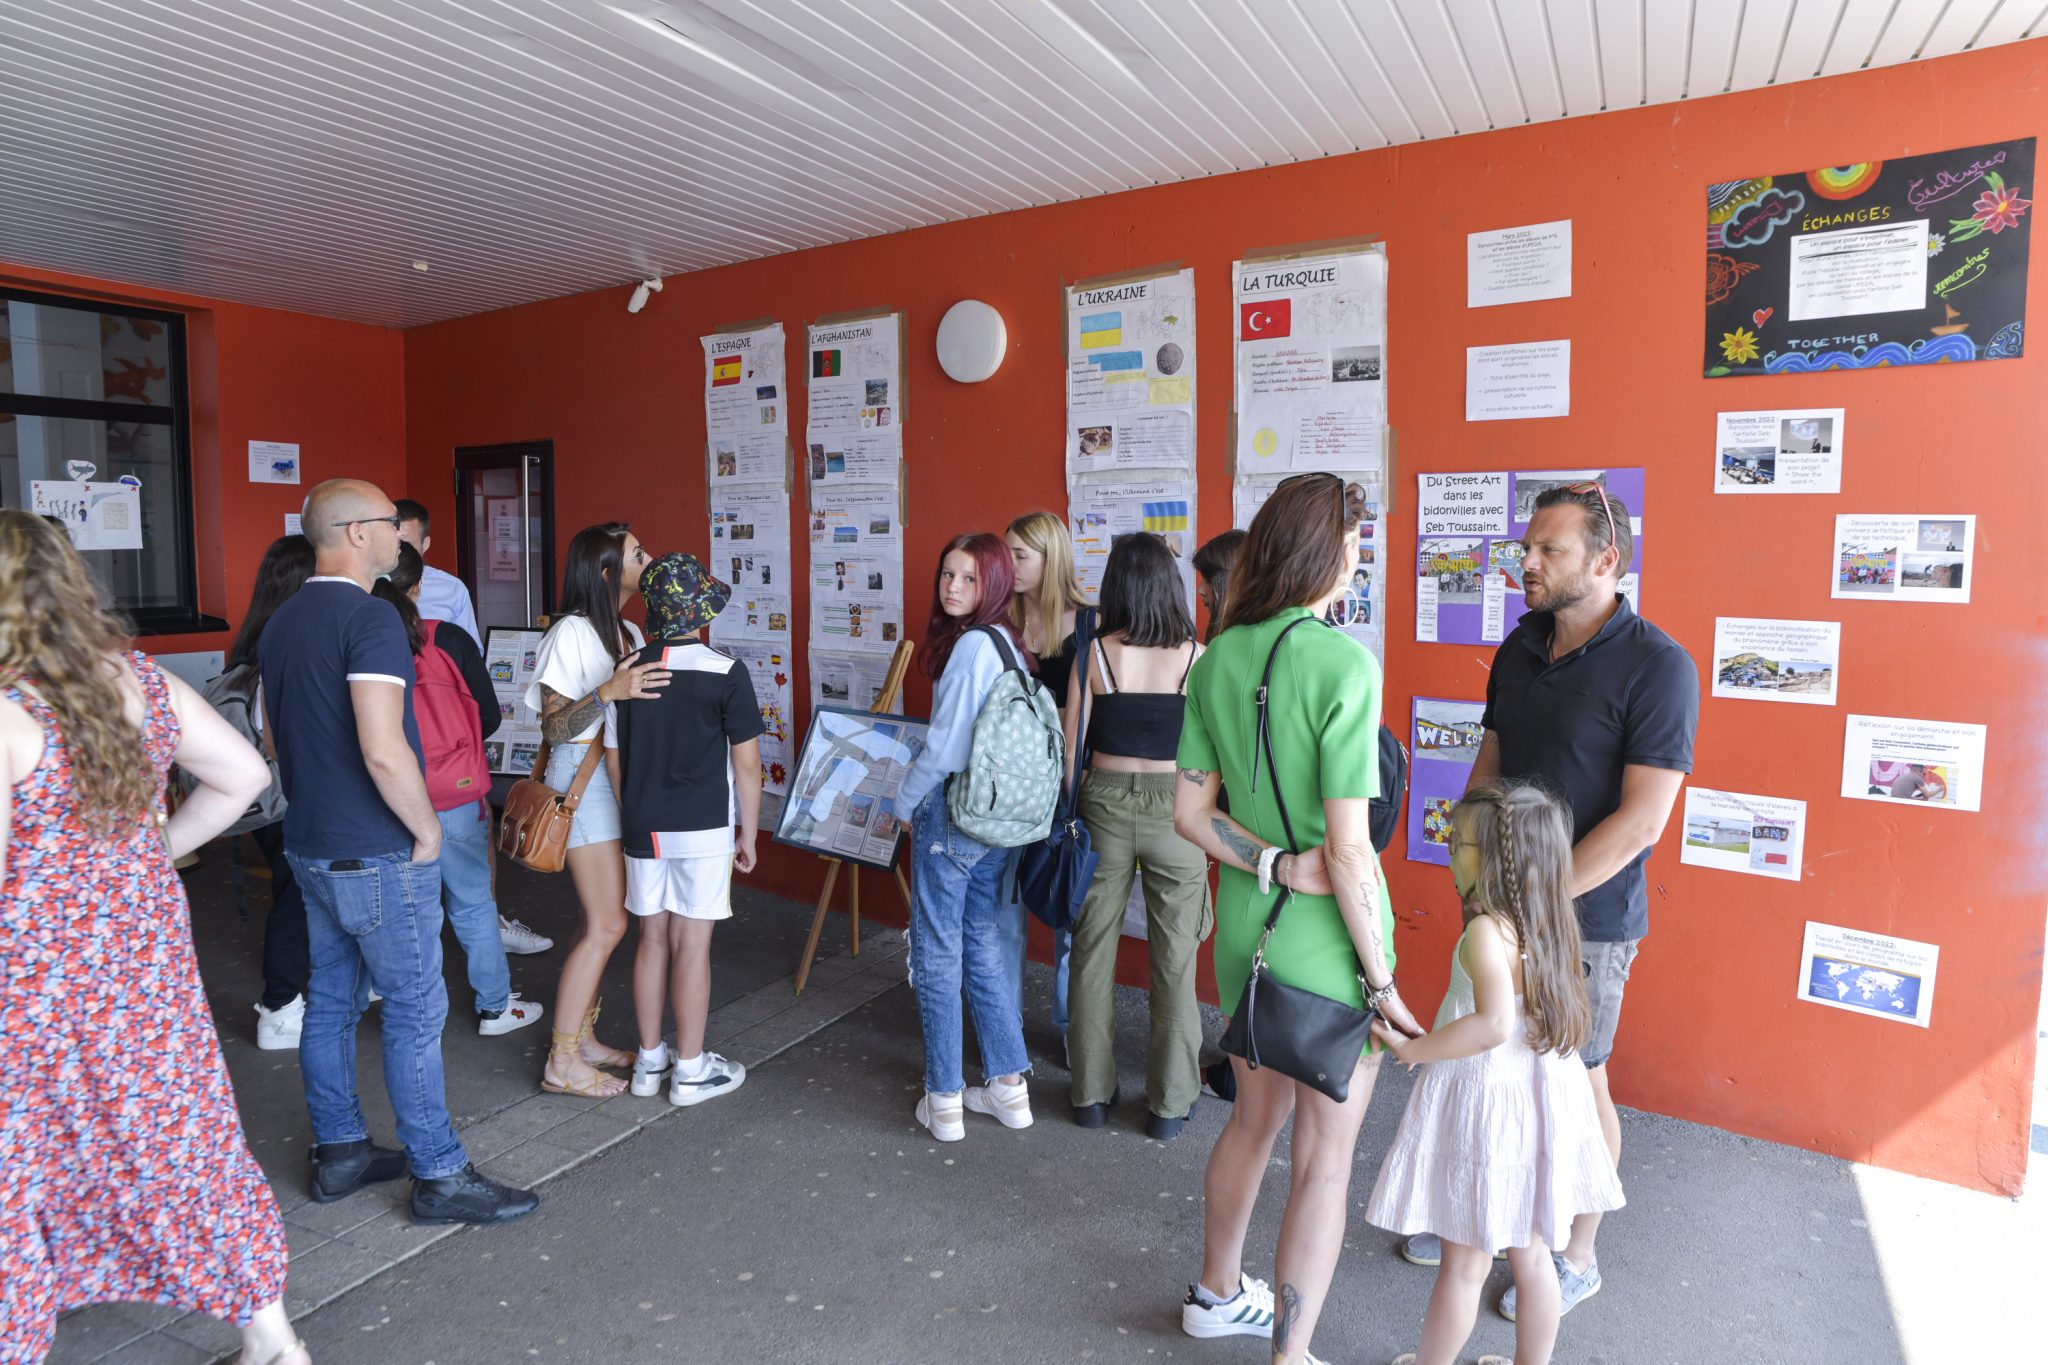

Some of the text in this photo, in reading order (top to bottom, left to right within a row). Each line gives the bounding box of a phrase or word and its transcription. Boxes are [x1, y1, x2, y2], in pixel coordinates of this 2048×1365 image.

[1802, 206, 1891, 232] ÉCHANGES
[1243, 268, 1335, 291] LA TURQUIE
[1078, 285, 1147, 306] L'UKRAINE
[811, 328, 871, 344] L'AFGHANISTAN
[1788, 332, 1879, 349] TOGETHER
[711, 337, 752, 353] L'ESPAGNE
[1427, 475, 1501, 487] Du Street Art
[1443, 491, 1484, 500] dans les
[1423, 505, 1503, 516] bidonvilles avec
[1425, 522, 1501, 533] Seb Toussaint.
